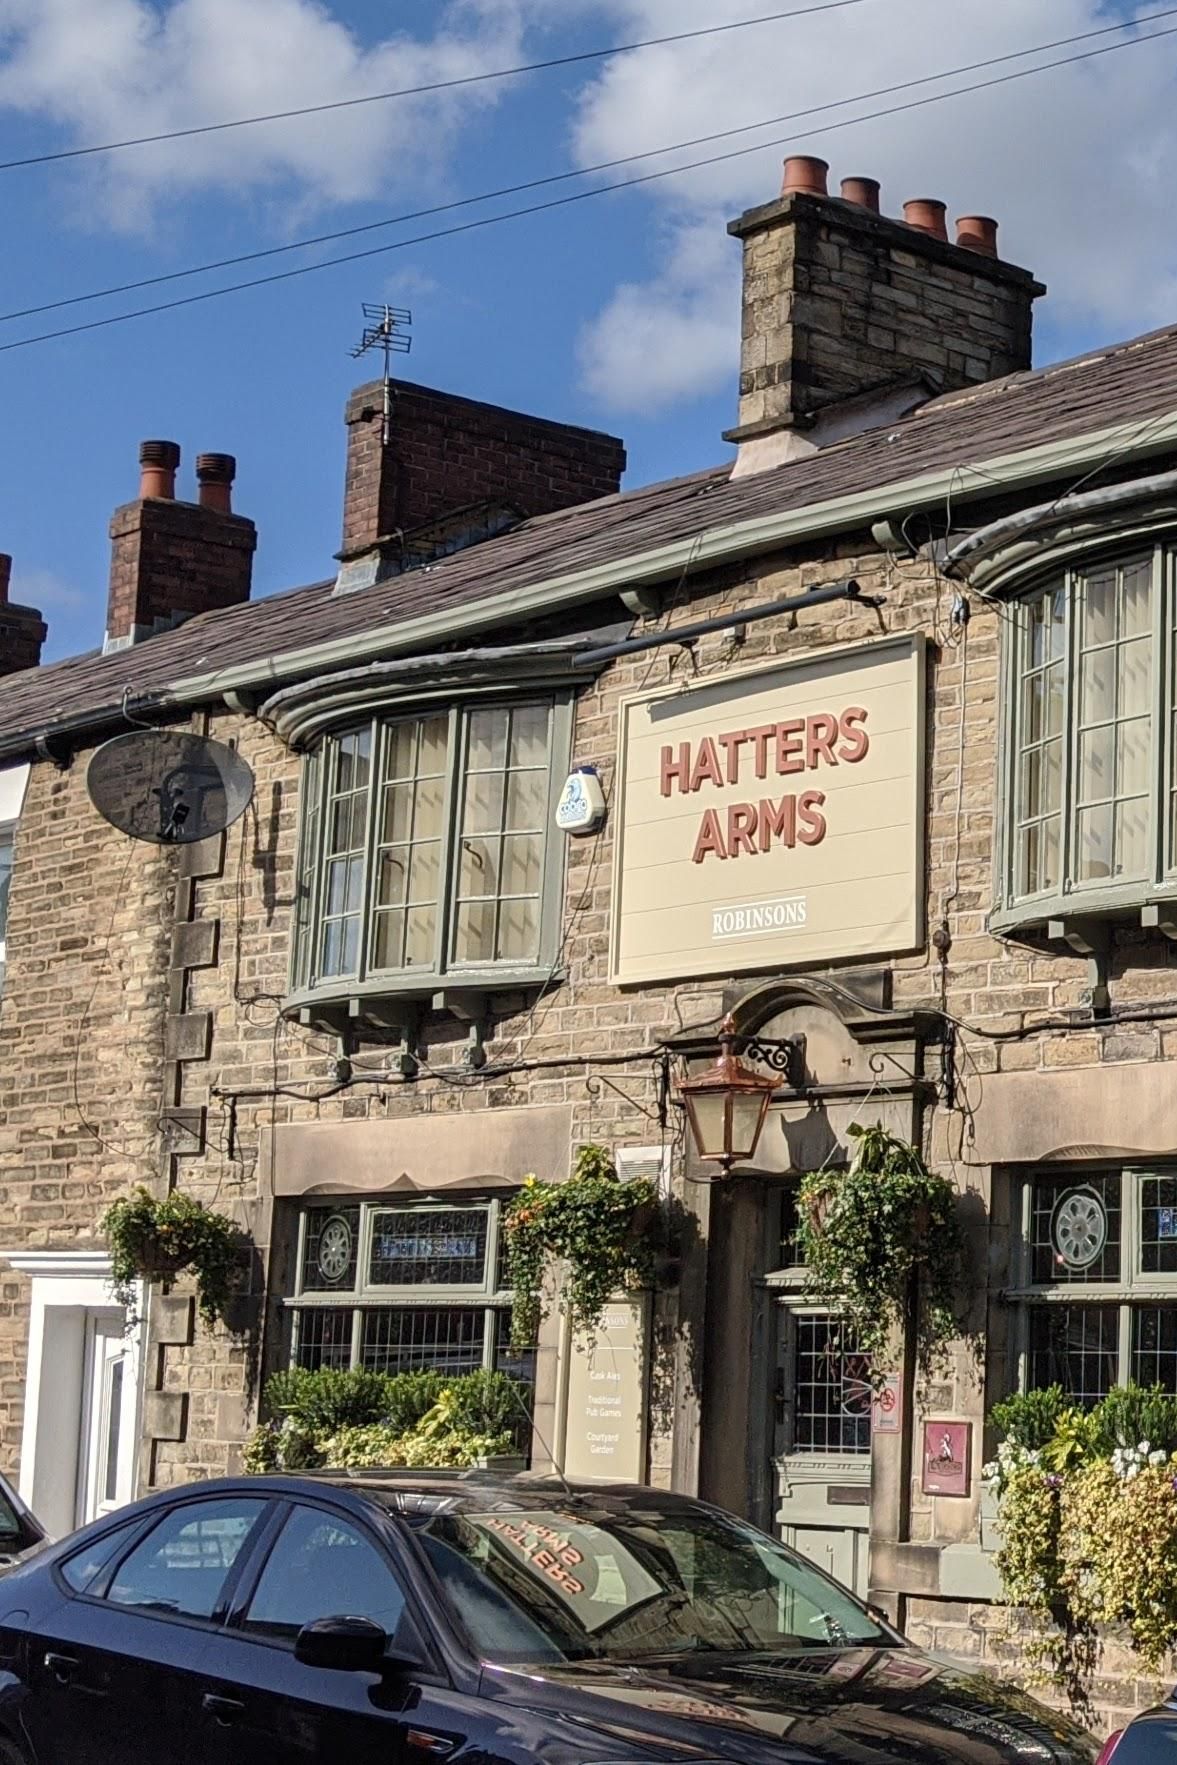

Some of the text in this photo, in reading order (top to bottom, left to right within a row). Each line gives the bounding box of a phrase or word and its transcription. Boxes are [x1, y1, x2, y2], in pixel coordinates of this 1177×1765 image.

[660, 707, 869, 797] HATTERS
[692, 790, 826, 864] ARMS
[712, 902, 807, 933] ROBINSONS
